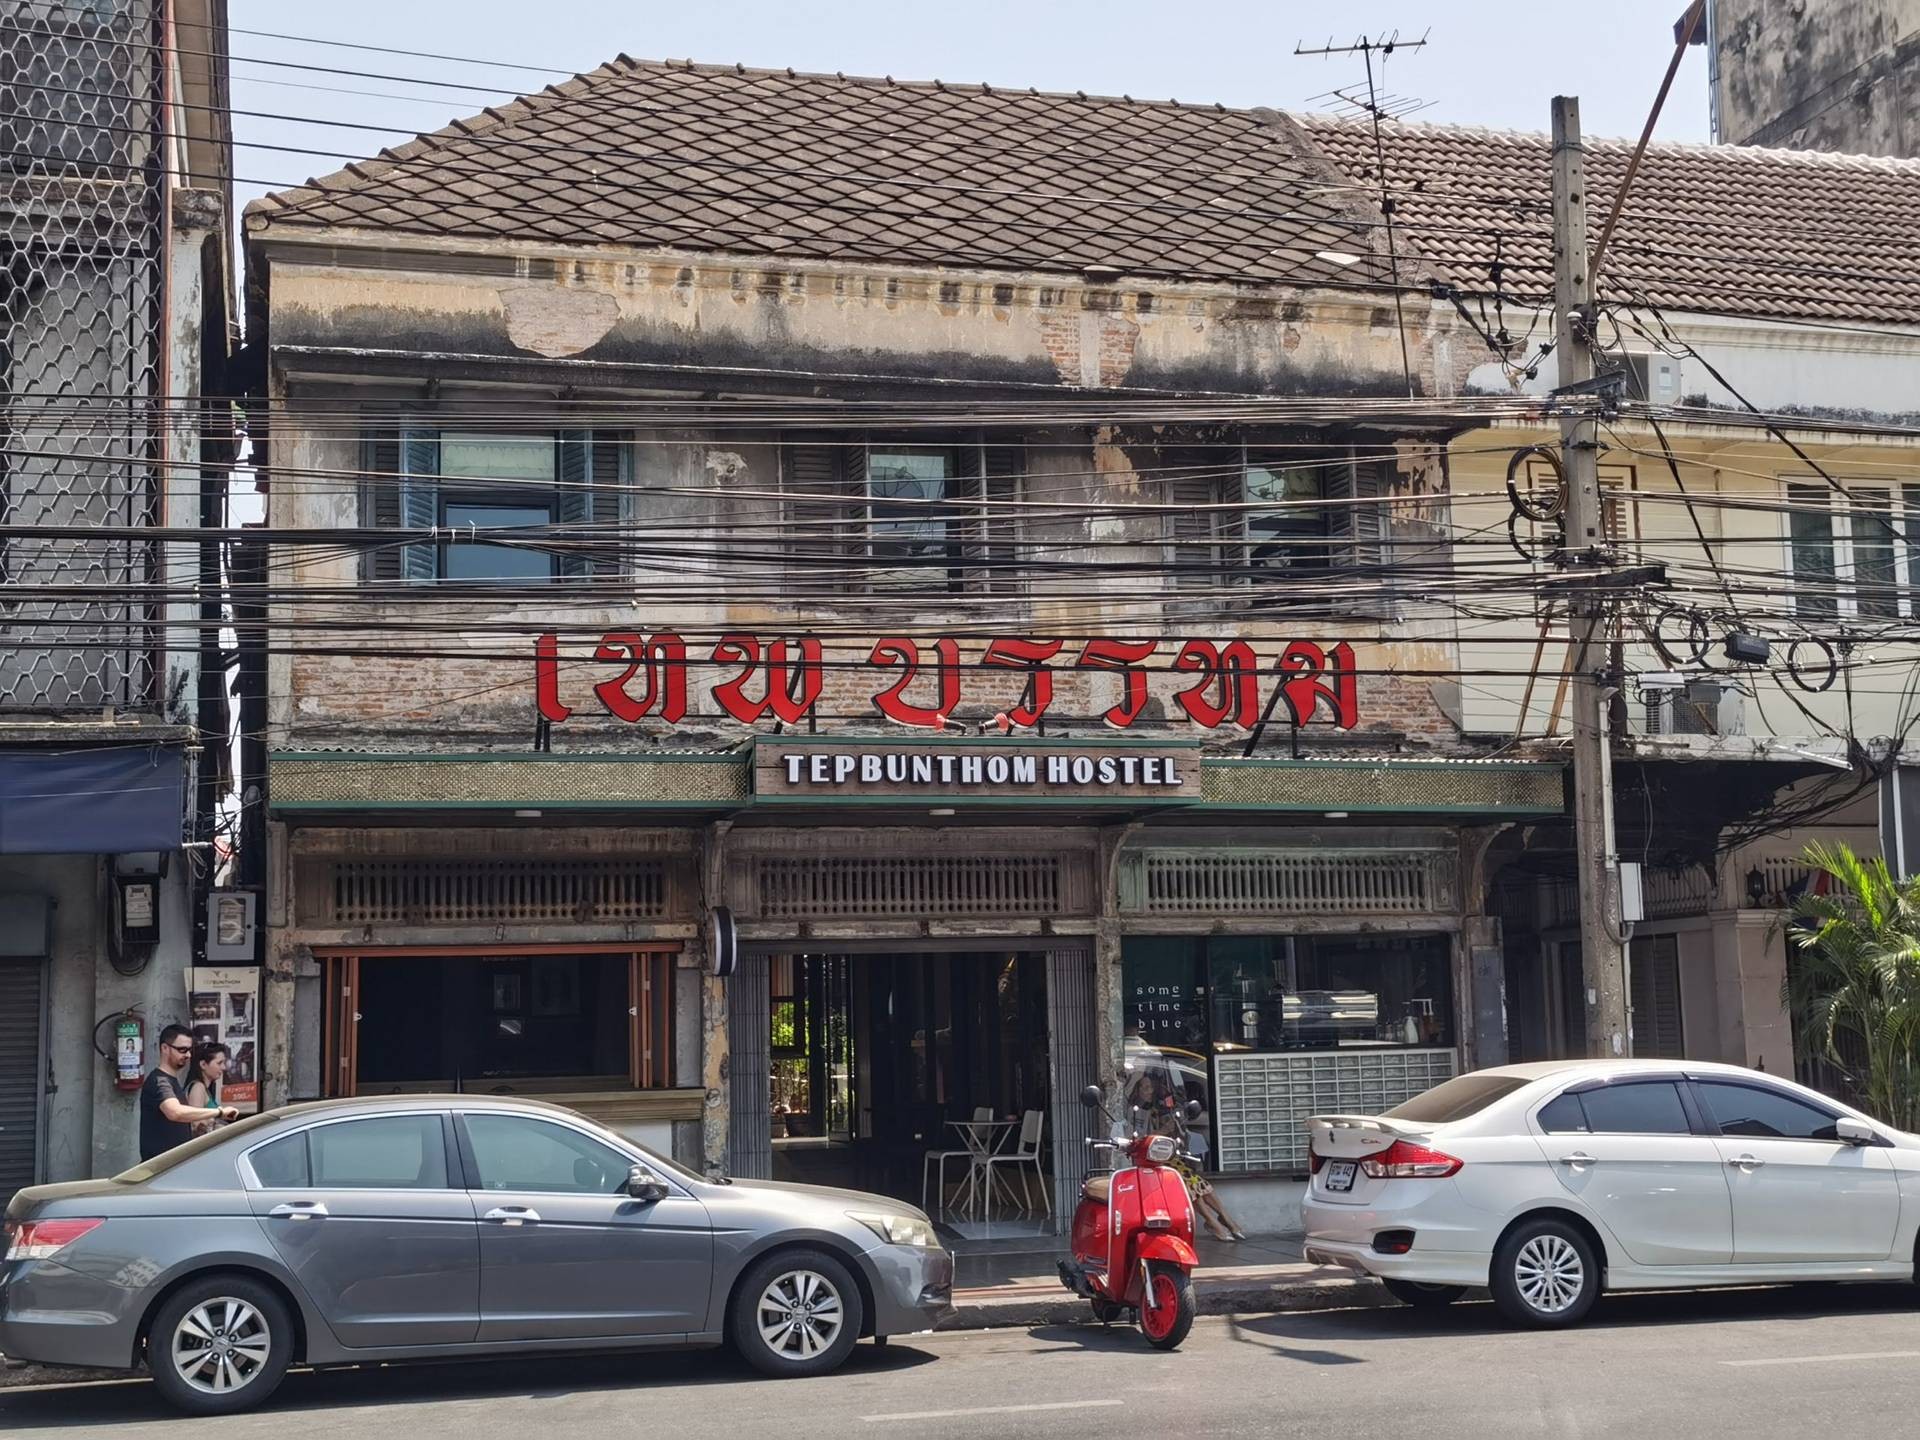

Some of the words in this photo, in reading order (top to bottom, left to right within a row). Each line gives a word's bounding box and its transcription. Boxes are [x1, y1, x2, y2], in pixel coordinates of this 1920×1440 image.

[783, 753, 1037, 784] TEPBUNTHOM
[1046, 755, 1183, 786] HOSTEL
[1136, 986, 1180, 998] some
[1138, 1001, 1180, 1012] time
[1138, 1018, 1181, 1031] blue
